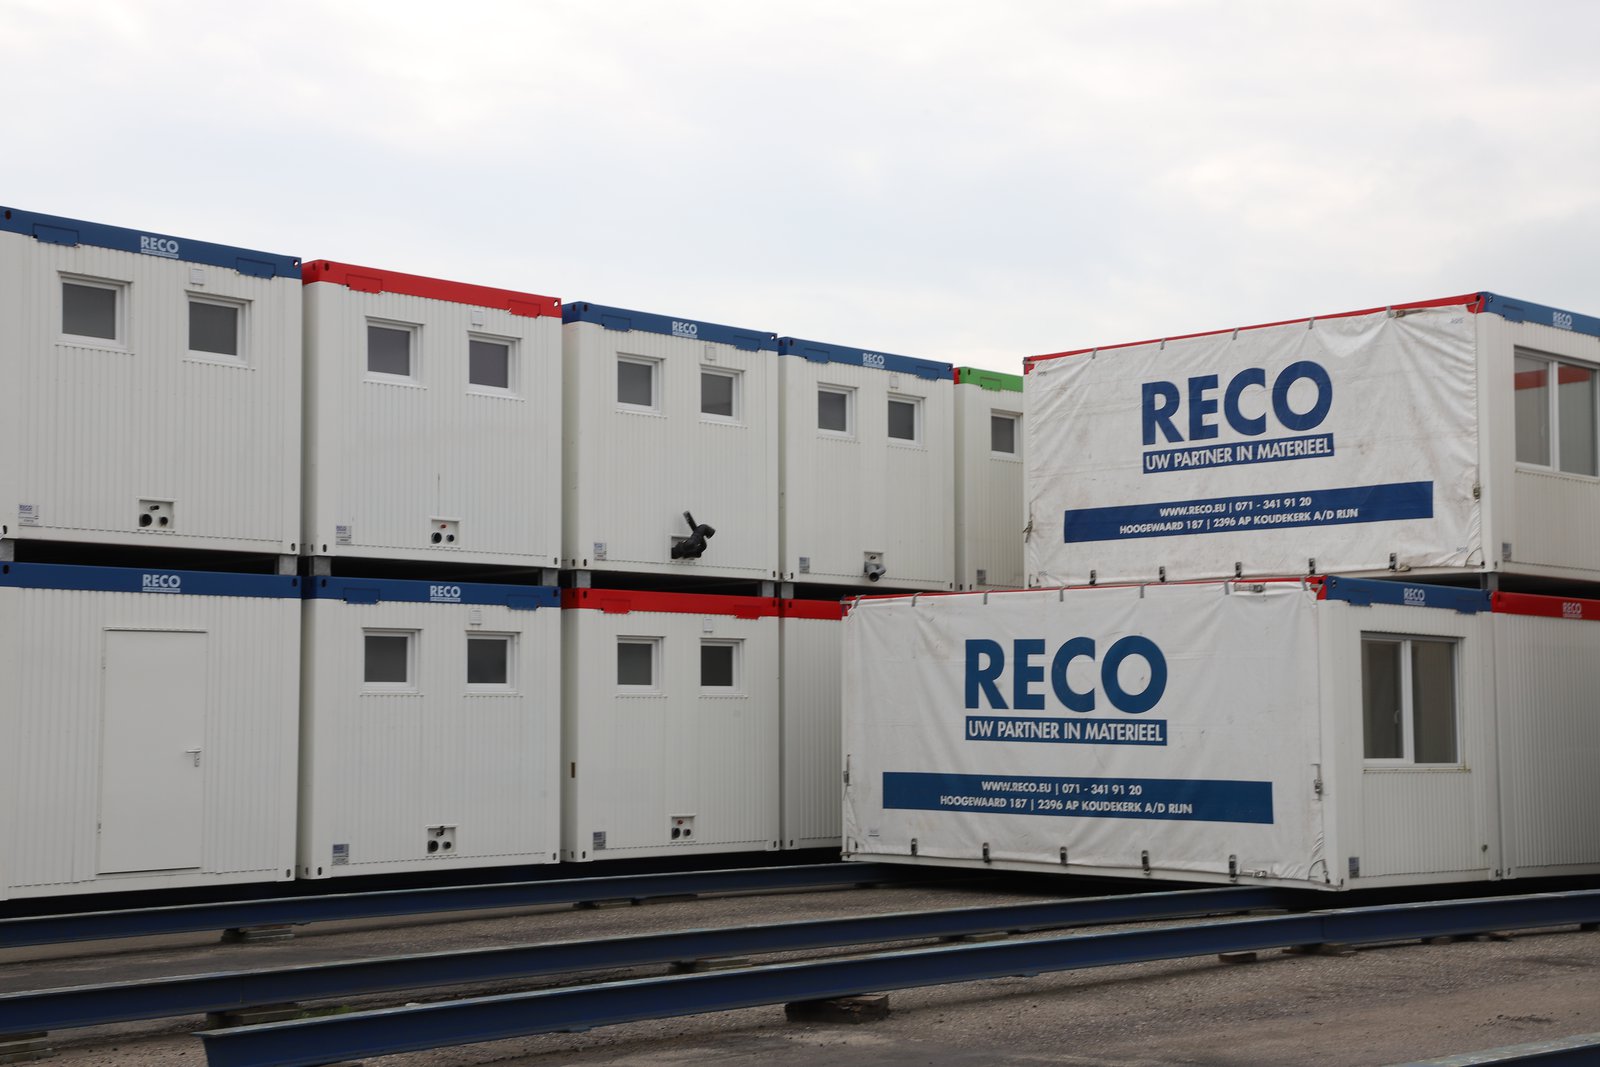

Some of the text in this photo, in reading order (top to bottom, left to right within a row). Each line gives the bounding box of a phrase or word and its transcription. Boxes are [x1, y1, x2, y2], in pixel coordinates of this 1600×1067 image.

[140, 236, 179, 253] RECO
[1553, 312, 1572, 326] RECO
[672, 321, 697, 334] RECO
[863, 353, 884, 365] RECO
[1142, 360, 1333, 445] RECO
[1146, 438, 1331, 470] UW PARTNER IN MATERIEEL
[1160, 502, 1226, 517] WWW.RECO.EU
[1235, 502, 1252, 511] 071
[1263, 499, 1280, 509] 341
[1285, 498, 1295, 507] 91
[1300, 497, 1312, 506] 20
[1120, 521, 1183, 534] HOOGEWAARD
[1187, 520, 1203, 529] 187
[1213, 517, 1235, 527] 2396
[1238, 516, 1251, 525] AP
[1254, 512, 1311, 524] KOUDEKERK
[1314, 510, 1334, 521] A/D
[1337, 509, 1359, 518] RIJN
[142, 574, 181, 587] RECO
[430, 586, 461, 597] RECO
[1404, 588, 1425, 601] RECO
[1563, 602, 1582, 614] RECO
[965, 635, 1168, 714] RECO
[969, 721, 1163, 742] UW PARTNER IN MATERIEEL
[981, 782, 1051, 792] WWW.RECO.EU
[1062, 784, 1080, 793] 071
[1091, 785, 1108, 794] 341
[1112, 785, 1124, 795] 91
[1129, 785, 1142, 795] 20
[940, 796, 1006, 808] HOOGEWAARD
[1010, 799, 1027, 808] 187
[1038, 800, 1063, 810] 2396
[1065, 800, 1079, 810] AP
[1082, 801, 1142, 812] KOUDEKERK
[1145, 802, 1165, 813] A/D
[1169, 804, 1192, 813] RIJN
